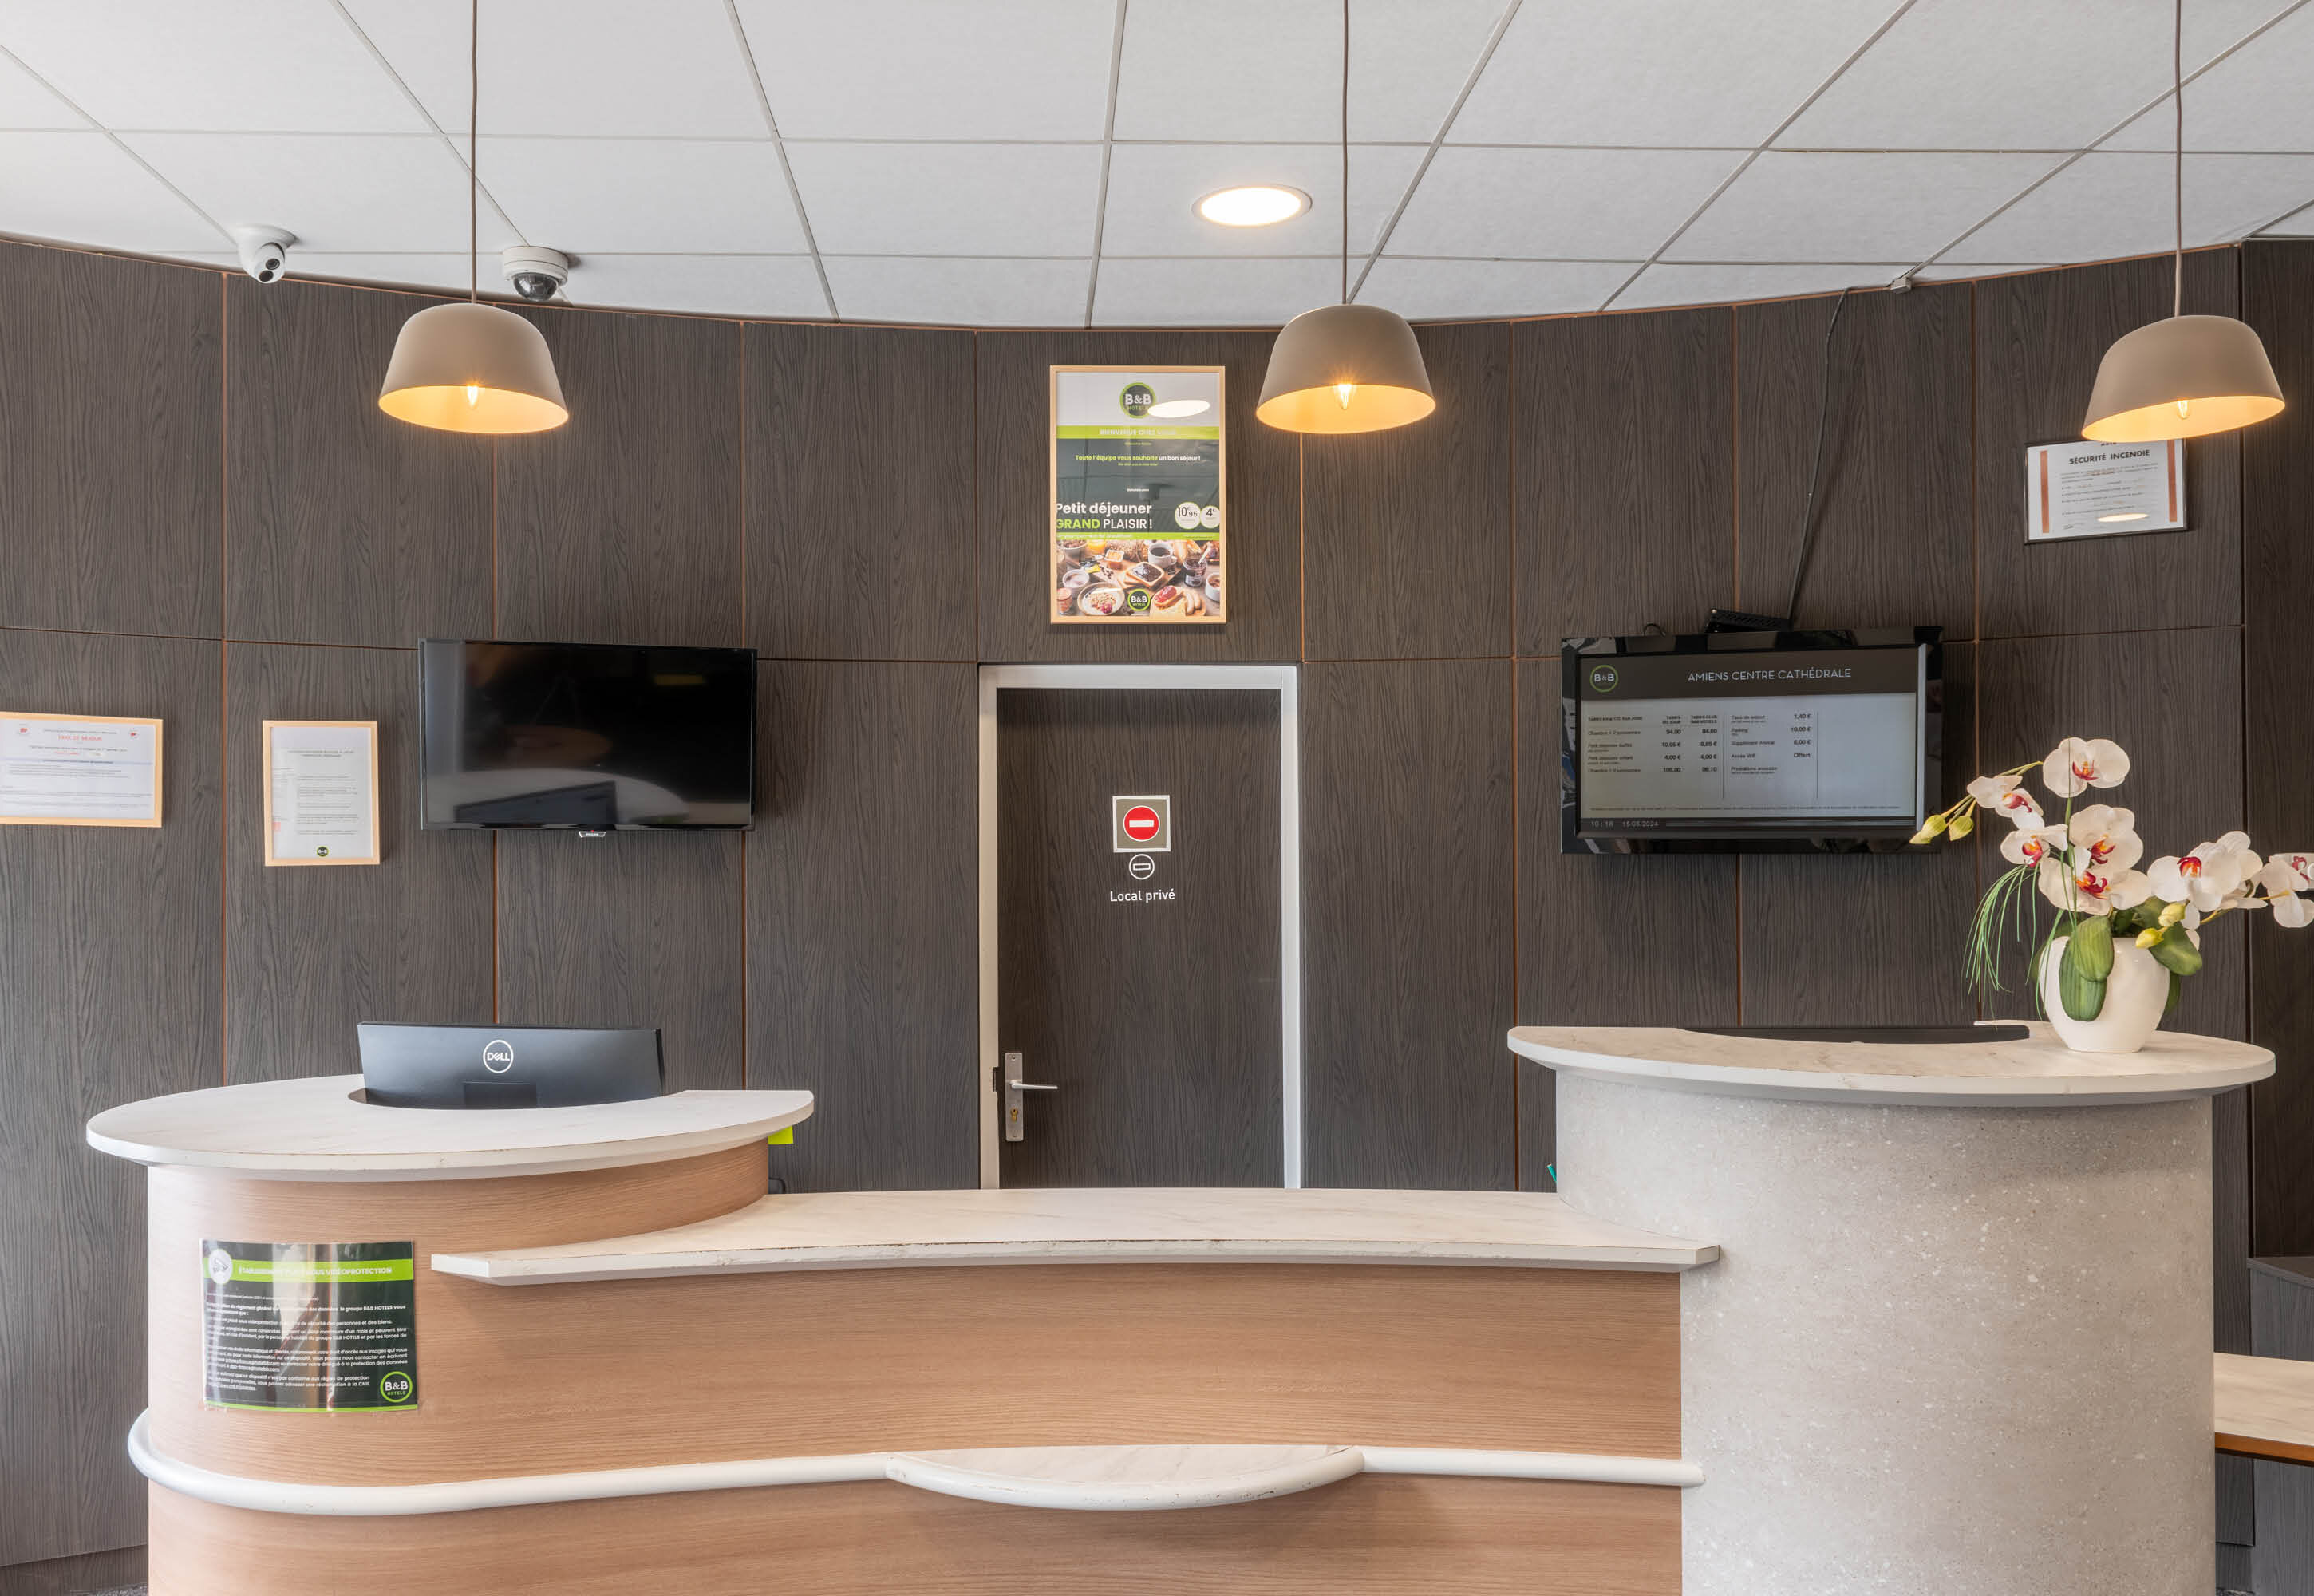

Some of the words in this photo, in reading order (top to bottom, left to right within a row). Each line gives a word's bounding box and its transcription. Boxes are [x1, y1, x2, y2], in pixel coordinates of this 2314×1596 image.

[1125, 393, 1152, 405] B&B
[2069, 453, 2106, 464] SÉCURITÉ
[2110, 449, 2150, 460] INCENDIE
[1056, 502, 1086, 514] Petit
[1089, 502, 1152, 517] déjeuner
[1056, 519, 1100, 529] GRAND
[1103, 519, 1146, 529] PLAISIR
[1594, 673, 1615, 682] B&B
[1687, 672, 1729, 682] AMIENS
[1732, 670, 1775, 681] CENTRE
[1777, 666, 1851, 680] CATHÉDRALE
[1110, 890, 1142, 902] Local
[1145, 888, 1175, 903] privé
[487, 1052, 510, 1061] DELL
[385, 1381, 408, 1391] B&B
